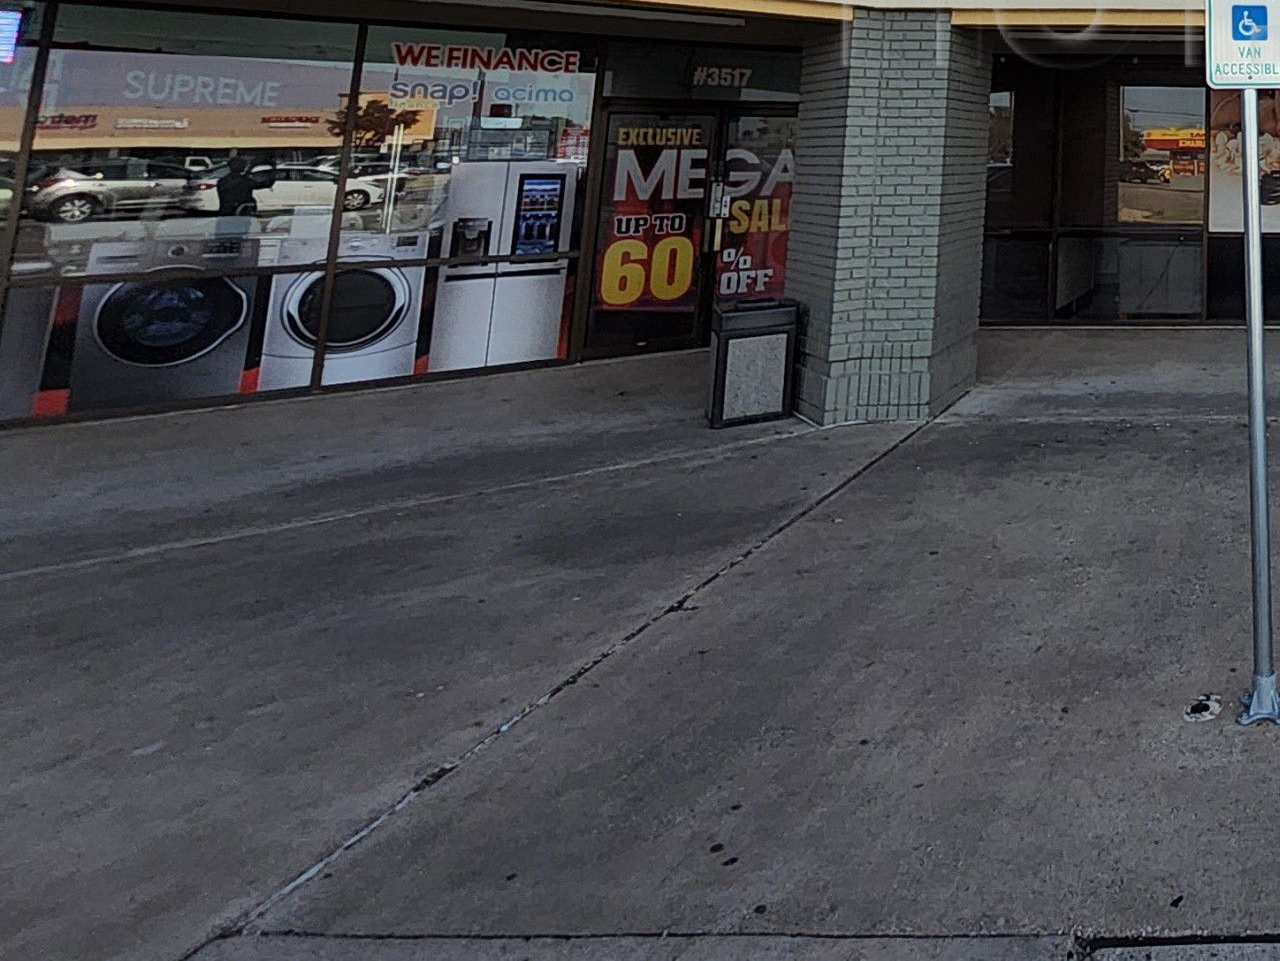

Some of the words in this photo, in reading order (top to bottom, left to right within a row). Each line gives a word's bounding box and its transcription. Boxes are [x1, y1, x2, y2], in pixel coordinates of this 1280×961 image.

[394, 42, 441, 69] WE
[445, 46, 580, 74] FINANCE
[1238, 46, 1261, 59] VAN
[123, 70, 281, 108] SUPREME
[693, 66, 752, 87] #3517
[390, 80, 480, 106] snap!
[494, 85, 574, 103] acima
[618, 127, 701, 146] EXCLUSIVE
[613, 149, 796, 201] MEGA
[616, 215, 649, 236] UP
[652, 213, 686, 234] TO
[729, 199, 788, 234] SAL
[601, 236, 694, 305] 60
[722, 246, 751, 270] %
[719, 269, 773, 295] OFF
